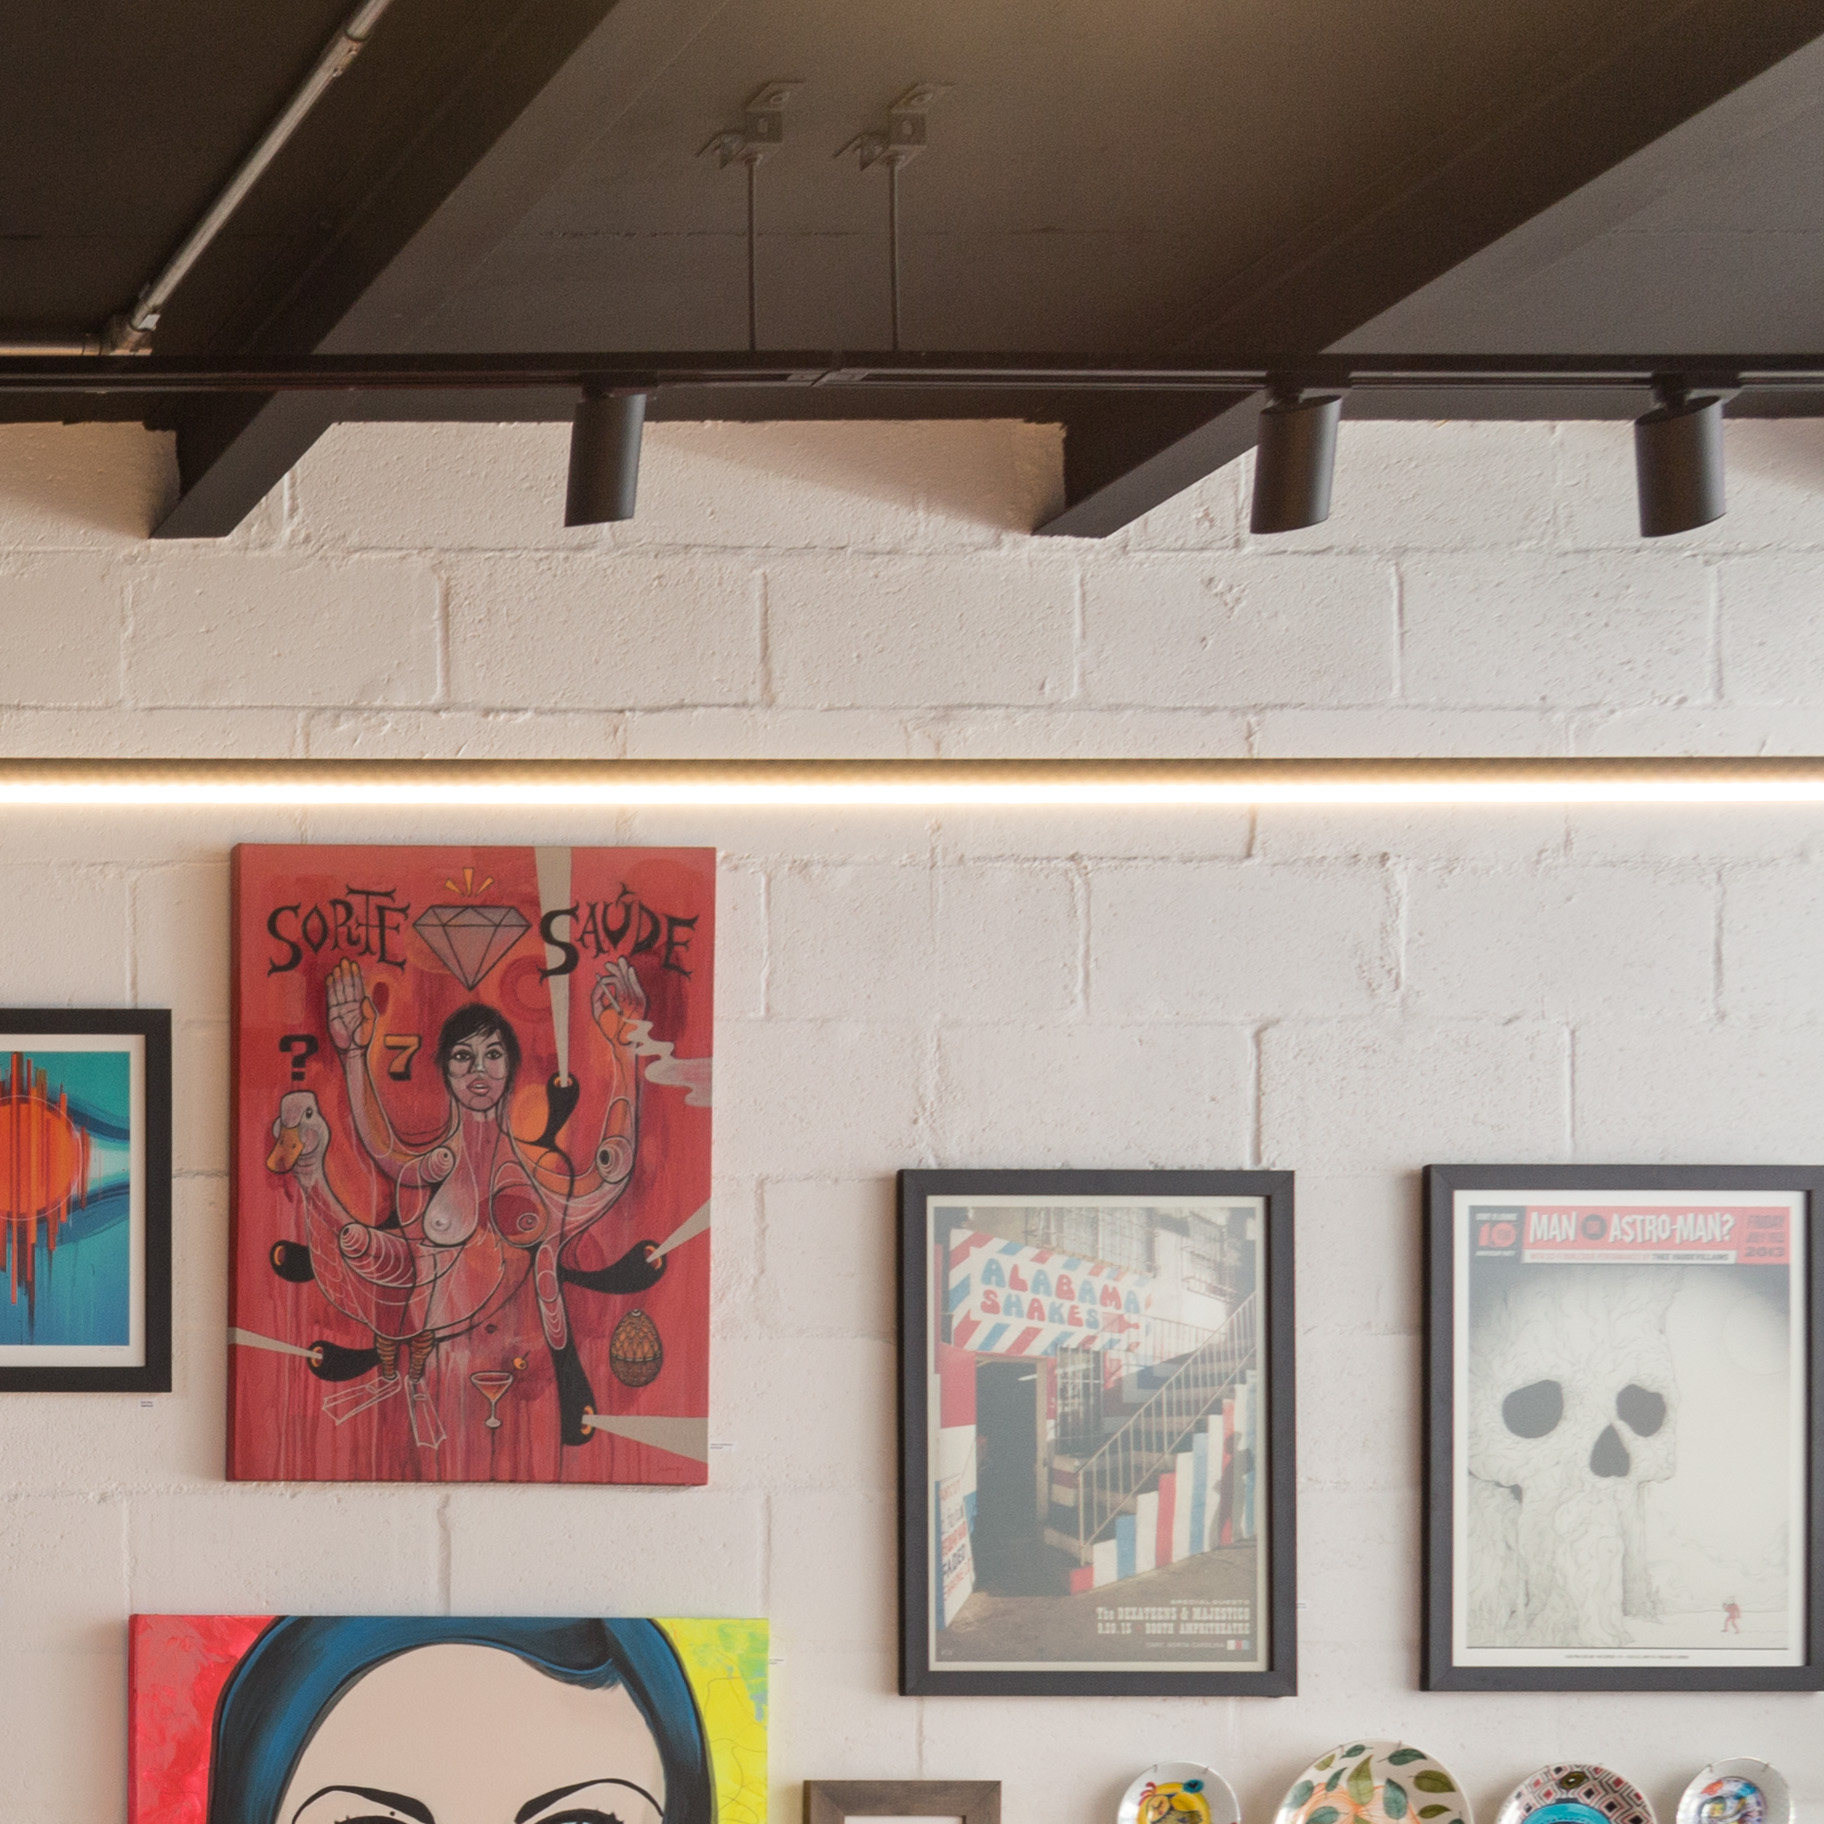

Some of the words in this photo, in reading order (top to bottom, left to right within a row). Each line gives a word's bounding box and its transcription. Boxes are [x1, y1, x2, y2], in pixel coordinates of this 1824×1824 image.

[266, 884, 411, 977] SORTE
[537, 882, 700, 980] SAÚDE
[1529, 1211, 1578, 1244] MAN
[1608, 1211, 1736, 1245] ASTRO-MAN?
[980, 1258, 1141, 1314] ALABAMA
[980, 1289, 1100, 1330] SHAKES
